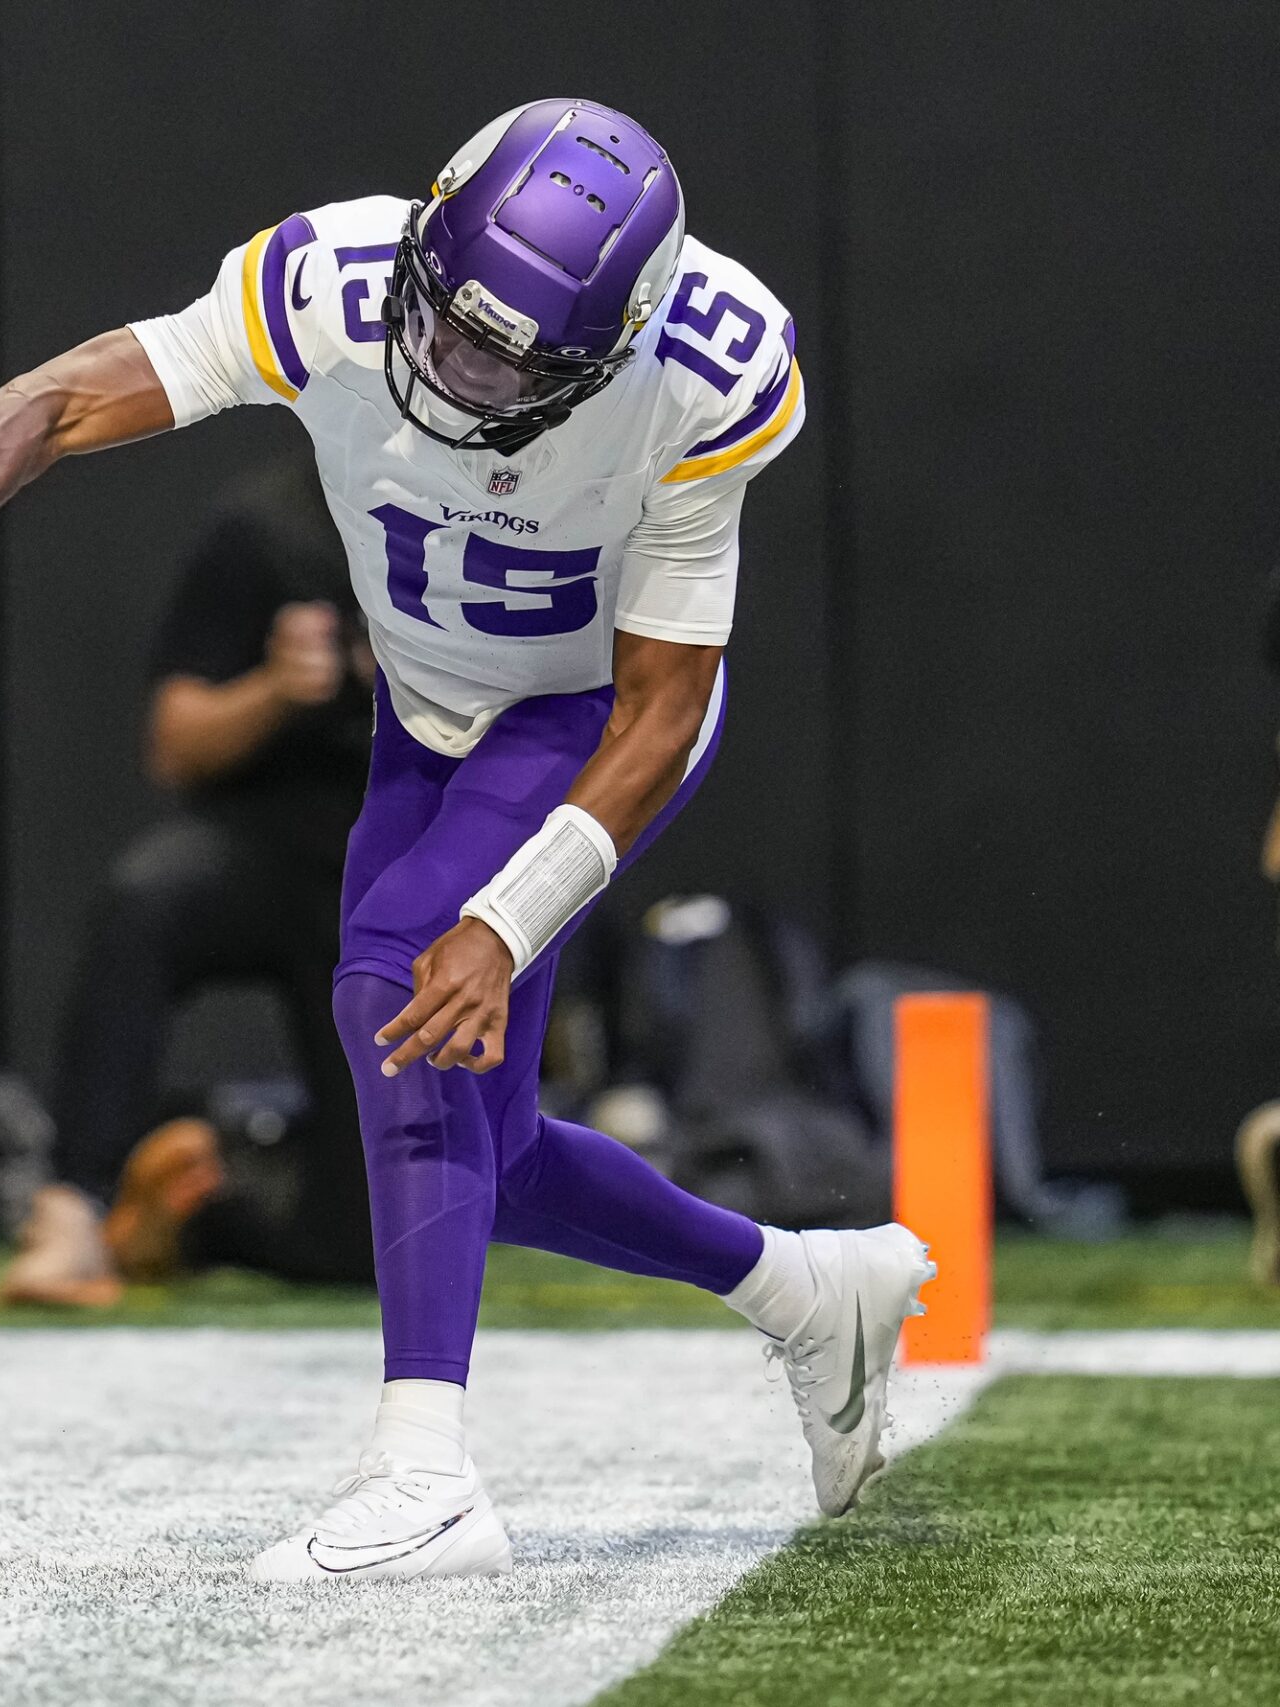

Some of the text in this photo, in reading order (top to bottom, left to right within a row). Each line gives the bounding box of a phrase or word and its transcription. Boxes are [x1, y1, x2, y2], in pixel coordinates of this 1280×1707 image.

[654, 271, 767, 398] 15
[490, 480, 514, 494] NFL
[367, 502, 604, 638] 15
